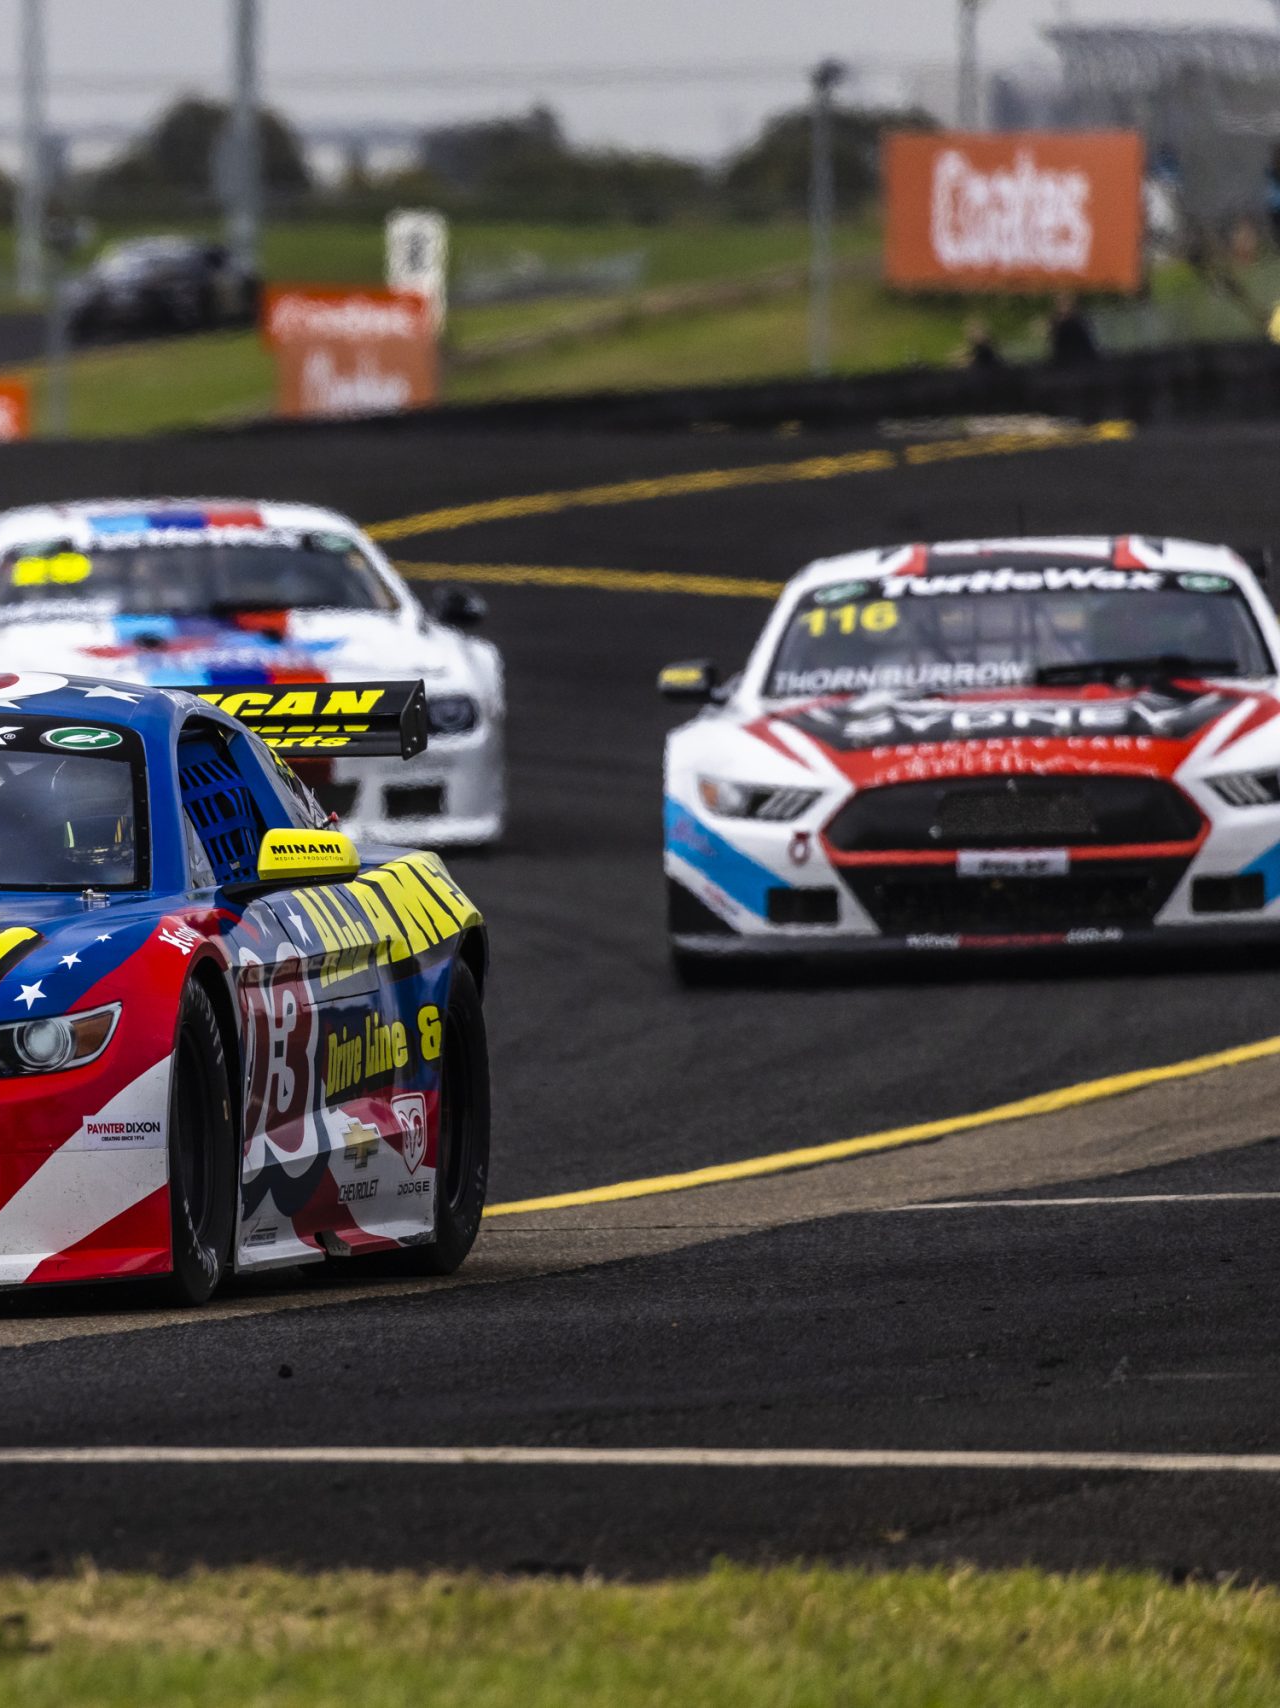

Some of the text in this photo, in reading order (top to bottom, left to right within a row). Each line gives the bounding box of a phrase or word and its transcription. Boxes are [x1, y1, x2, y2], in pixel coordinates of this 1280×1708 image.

[880, 567, 1166, 598] TurtleWax
[799, 600, 898, 637] 116
[774, 661, 1029, 693] THORNBURROW
[270, 844, 341, 854] MINAMI
[325, 1005, 442, 1098] Drive Line &
[87, 1122, 161, 1134] PAYNTER DIXON
[339, 1179, 379, 1201] CHEVROLET
[397, 1180, 430, 1196] DODGE
